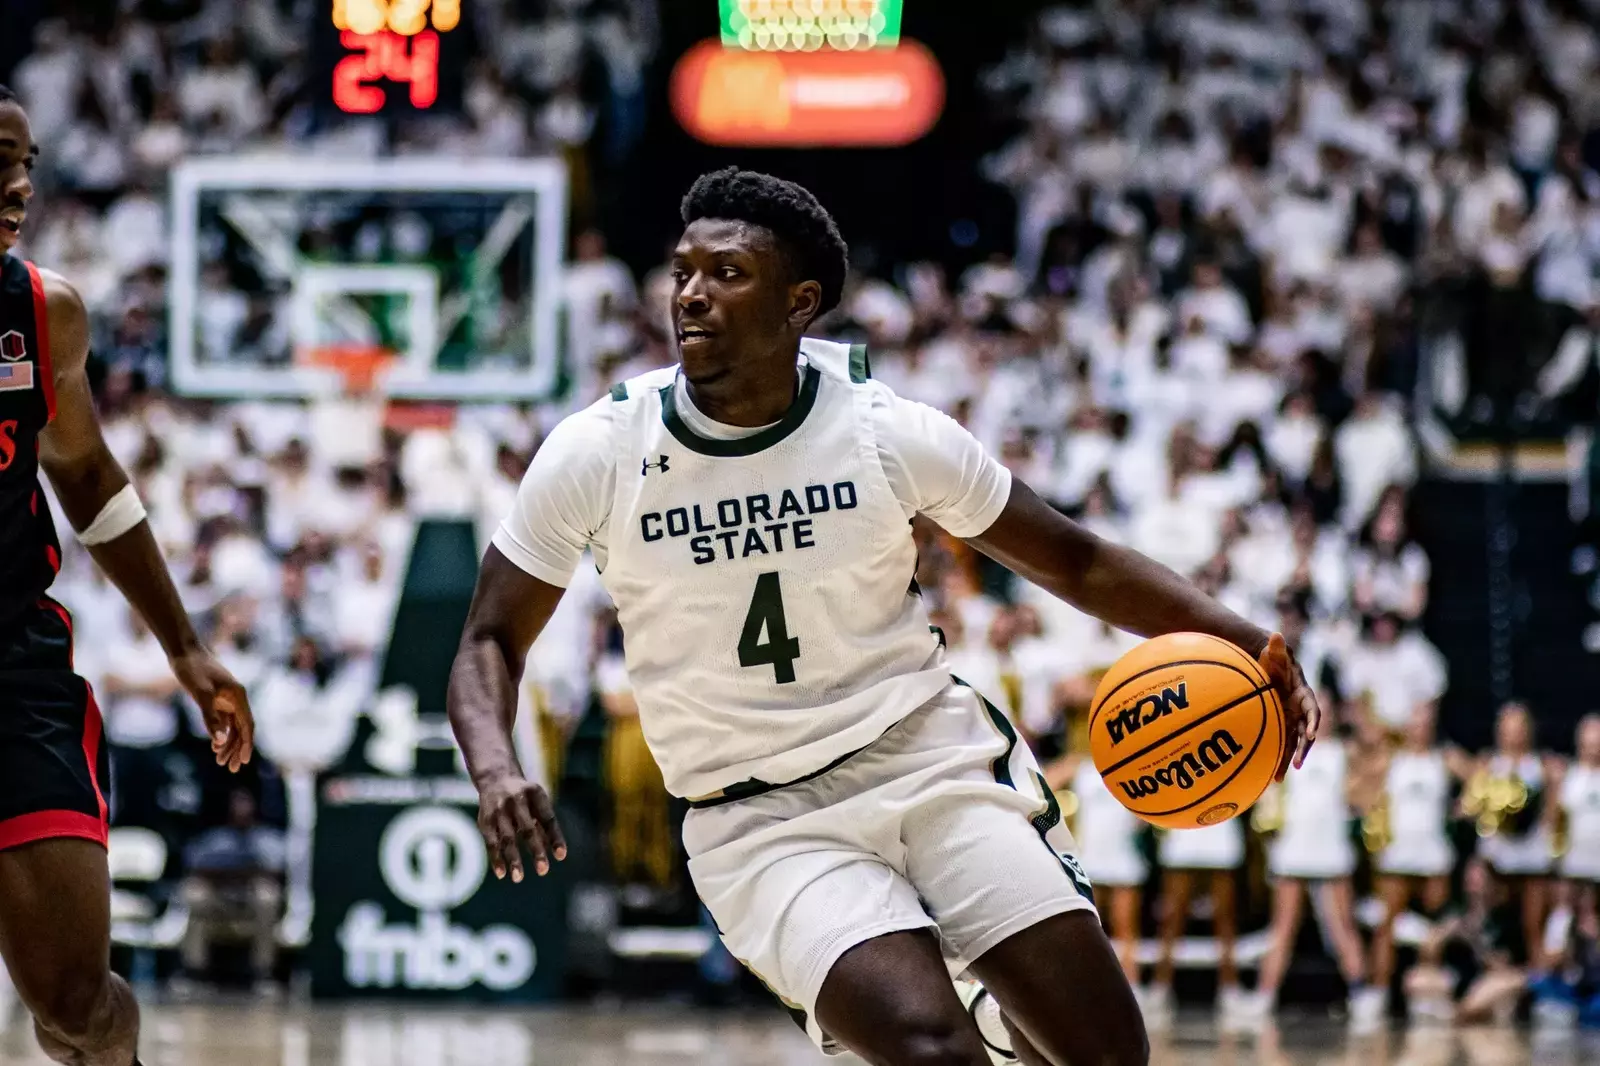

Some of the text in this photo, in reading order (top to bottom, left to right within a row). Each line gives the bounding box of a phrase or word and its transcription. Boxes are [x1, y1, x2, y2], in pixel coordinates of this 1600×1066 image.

[333, 28, 439, 113] 24
[640, 480, 858, 542] COLORADO
[690, 519, 815, 565] STATE
[737, 571, 800, 684] 4
[1105, 681, 1190, 745] NCAA
[1118, 729, 1243, 800] Wilson
